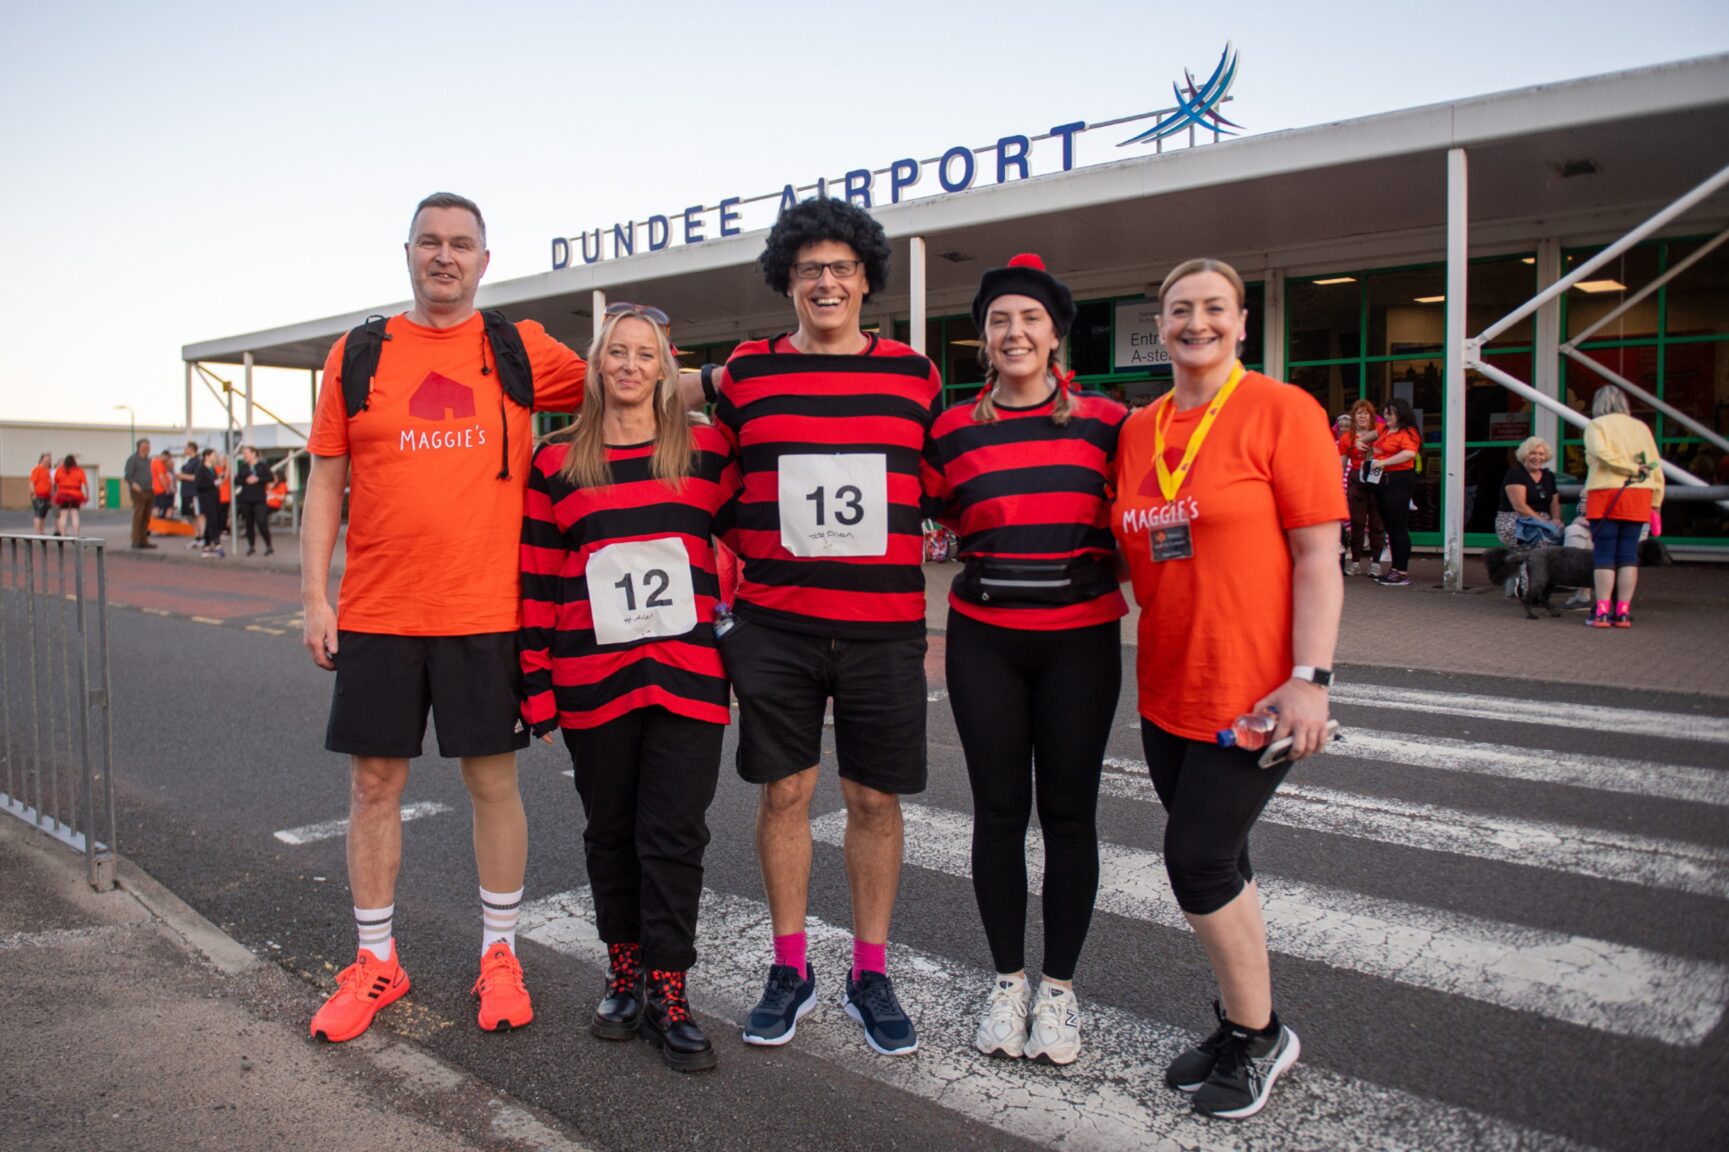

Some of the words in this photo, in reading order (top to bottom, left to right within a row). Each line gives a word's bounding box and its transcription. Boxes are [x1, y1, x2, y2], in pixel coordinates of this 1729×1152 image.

[551, 197, 743, 270] DUNDEE
[777, 121, 1087, 221] AIRPORT
[1130, 332, 1160, 347] Entr
[1131, 348, 1172, 364] A-ste
[399, 425, 487, 452] MAGGIE'S
[805, 484, 865, 526] 13
[1122, 495, 1200, 534] MAGGIE'S
[614, 568, 673, 611] 12
